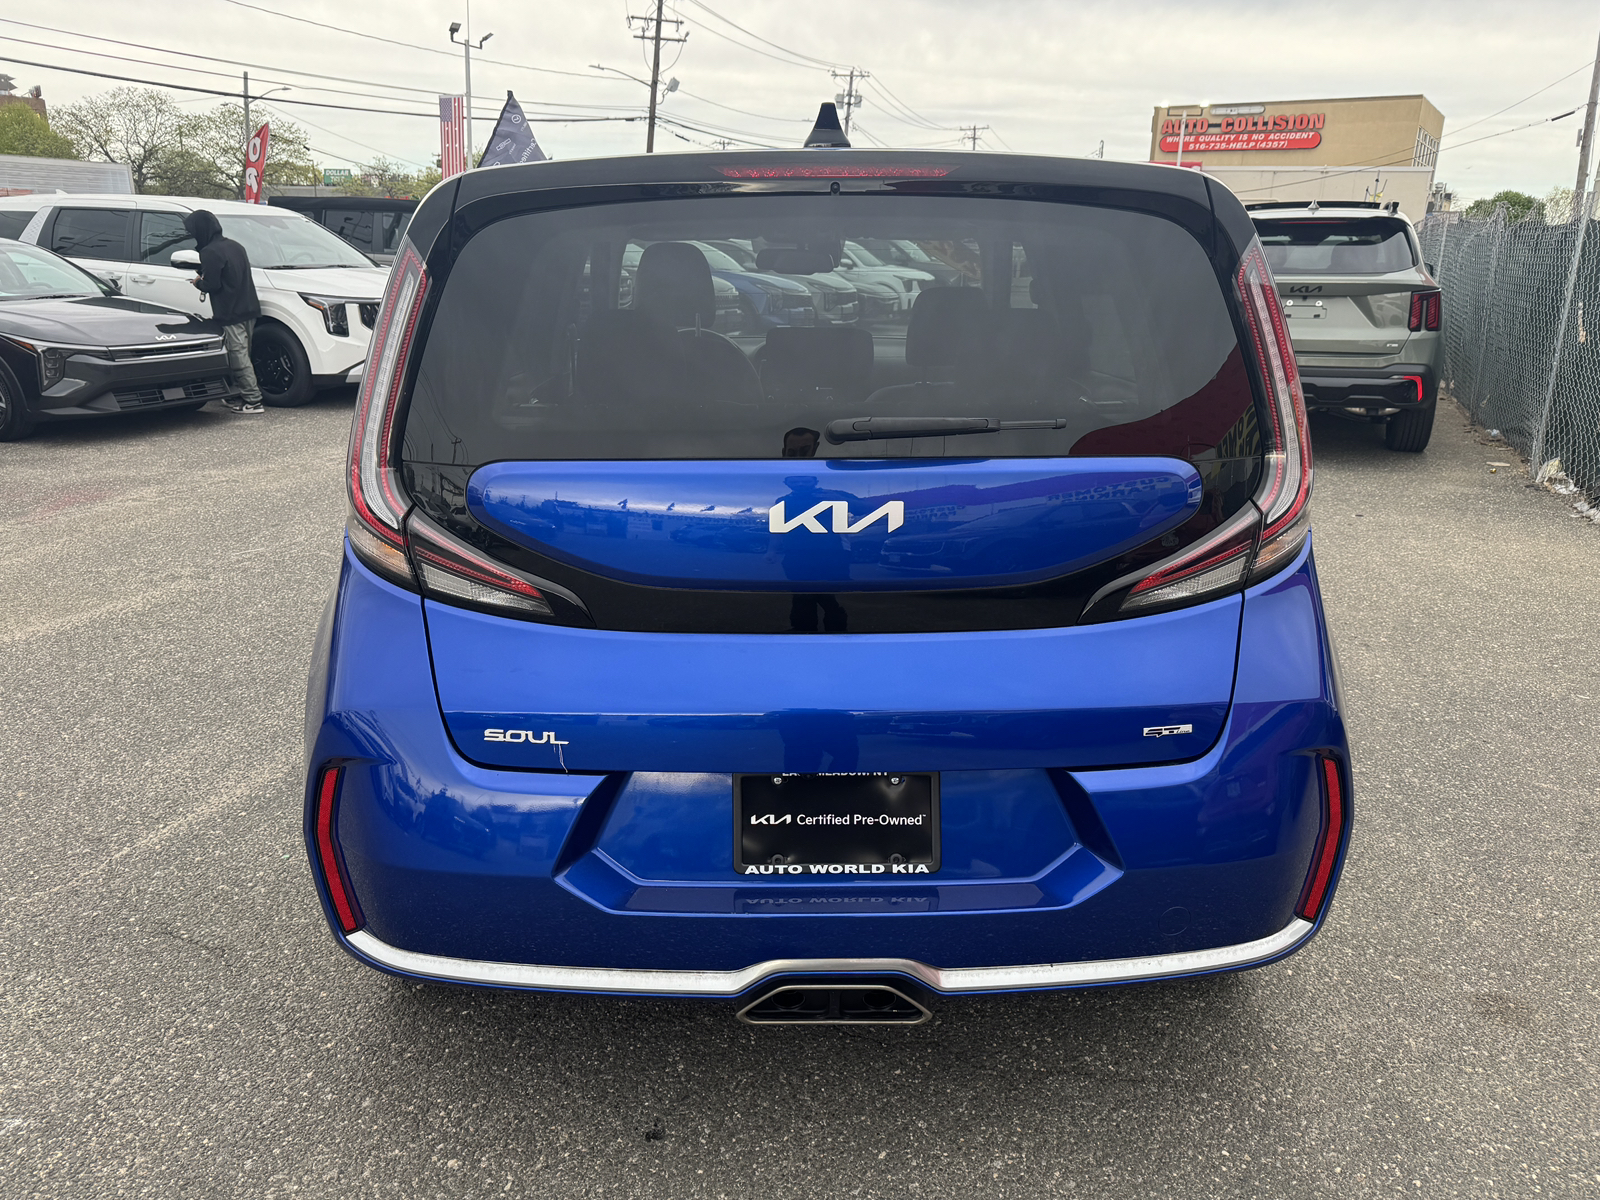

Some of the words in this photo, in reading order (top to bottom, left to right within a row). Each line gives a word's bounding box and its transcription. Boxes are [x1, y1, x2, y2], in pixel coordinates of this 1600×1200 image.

[1162, 117, 1209, 134] AUTO
[1221, 113, 1325, 133] COLLISION
[1166, 135, 1196, 143] WHRE
[1199, 134, 1236, 142] QUALITY
[1268, 132, 1315, 140] ACCIDENT
[1188, 142, 1256, 151] 516-735-HELP
[1256, 140, 1288, 149] (4357)
[768, 500, 905, 534] KIA
[483, 728, 570, 745] SOUL
[750, 814, 792, 825] KIA
[796, 814, 850, 826] Certified
[744, 864, 803, 875] AUTO
[809, 864, 886, 874] WORLD
[892, 863, 930, 874] KIA
